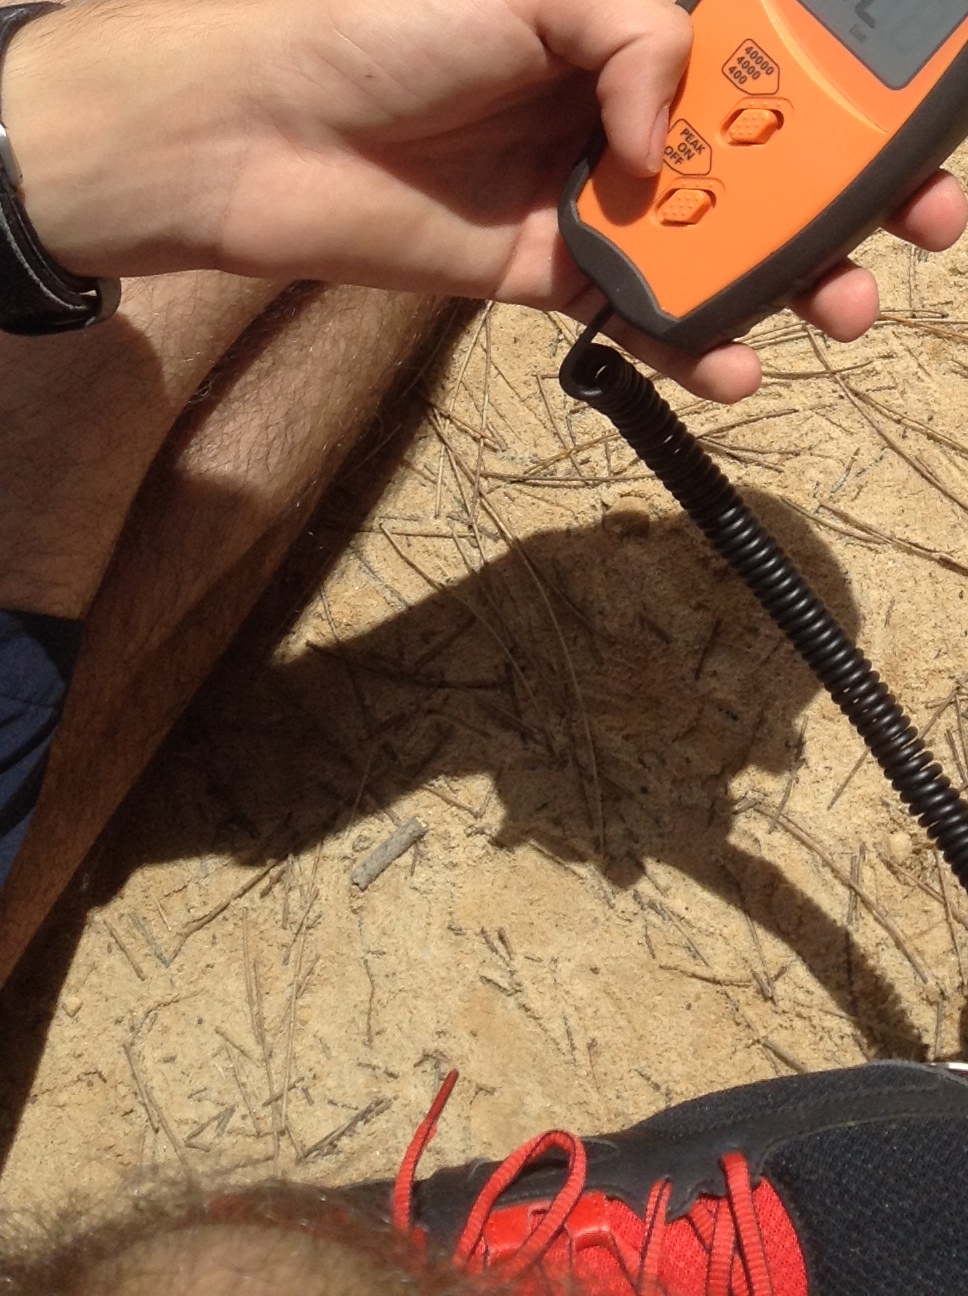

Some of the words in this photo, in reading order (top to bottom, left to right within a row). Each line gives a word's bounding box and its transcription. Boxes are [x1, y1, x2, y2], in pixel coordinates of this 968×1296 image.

[735, 55, 762, 81] 4000
[743, 45, 775, 76] 40000
[726, 64, 748, 85] 400
[676, 141, 696, 161] ON
[679, 127, 706, 155] PEAK
[662, 144, 684, 165] OFF
